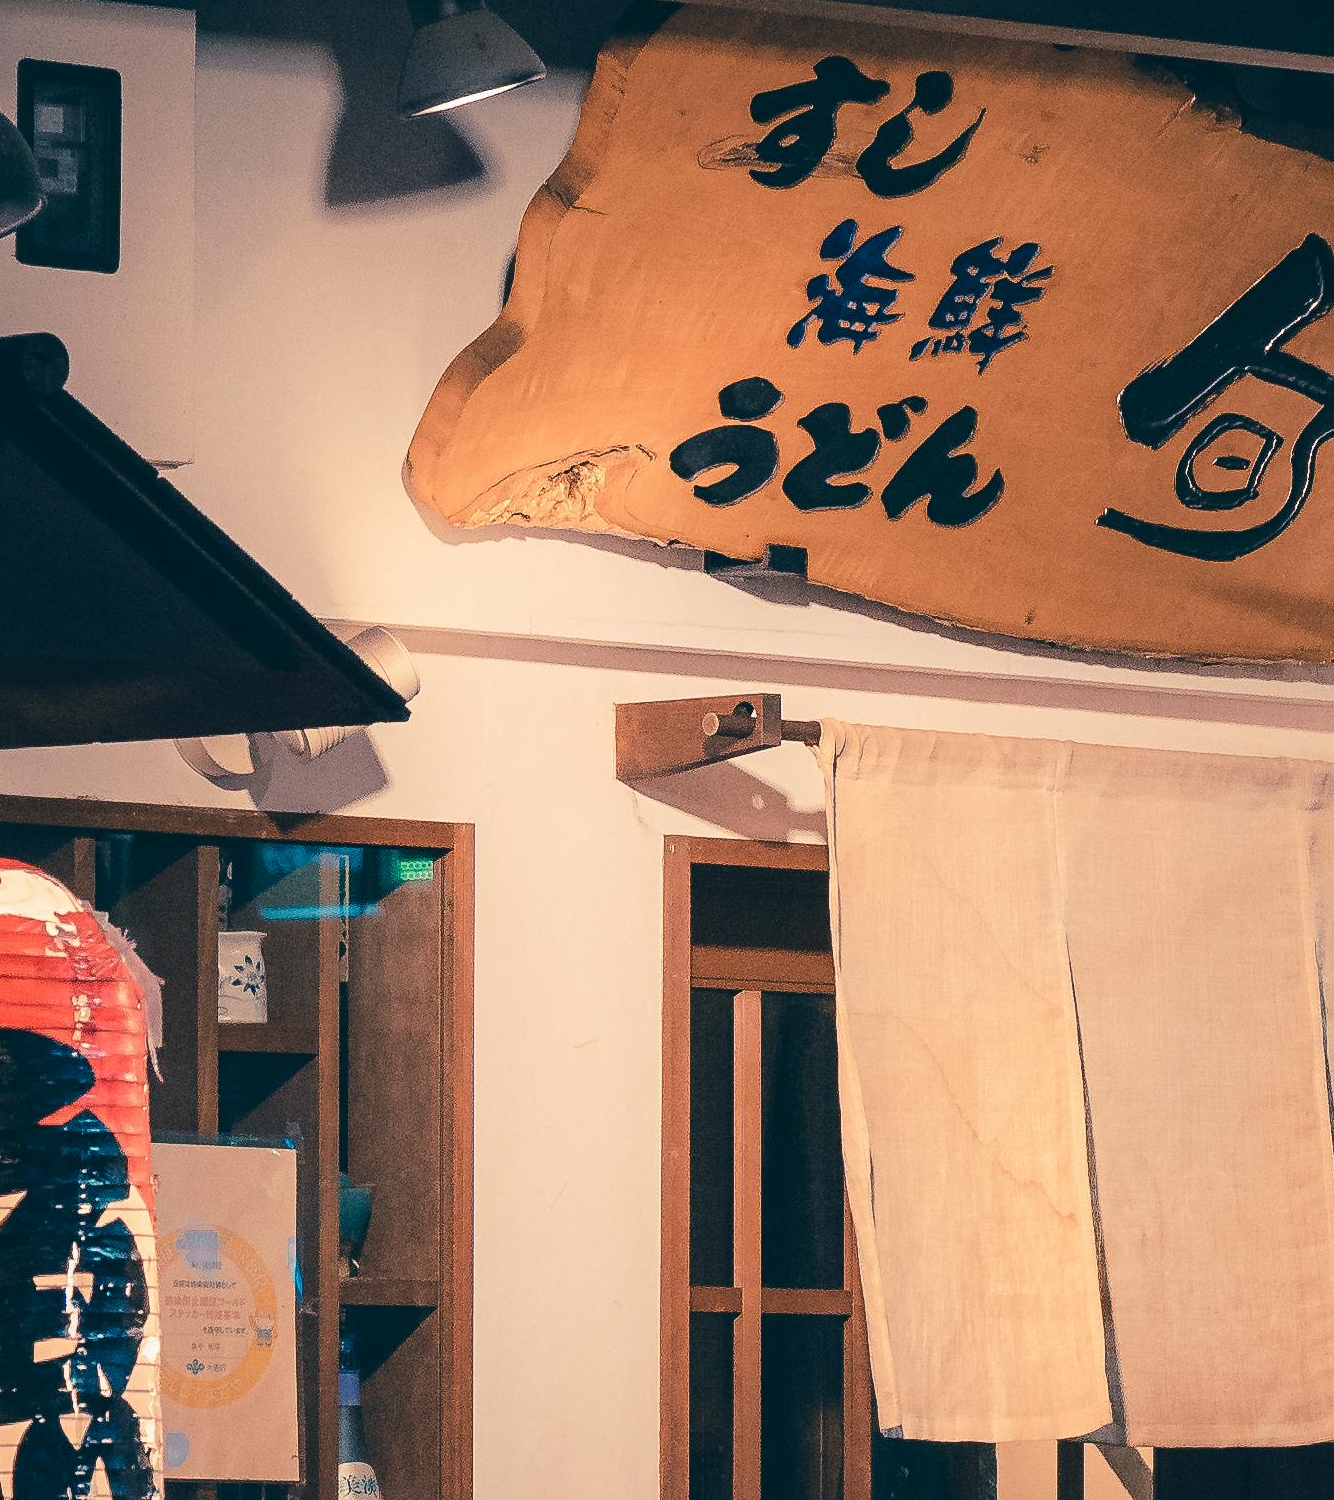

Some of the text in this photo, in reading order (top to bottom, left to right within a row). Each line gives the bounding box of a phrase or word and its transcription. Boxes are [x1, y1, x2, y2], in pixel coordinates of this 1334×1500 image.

[749, 55, 986, 198] すし
[786, 218, 1055, 370] 海鮮
[669, 376, 1005, 527] うどん
